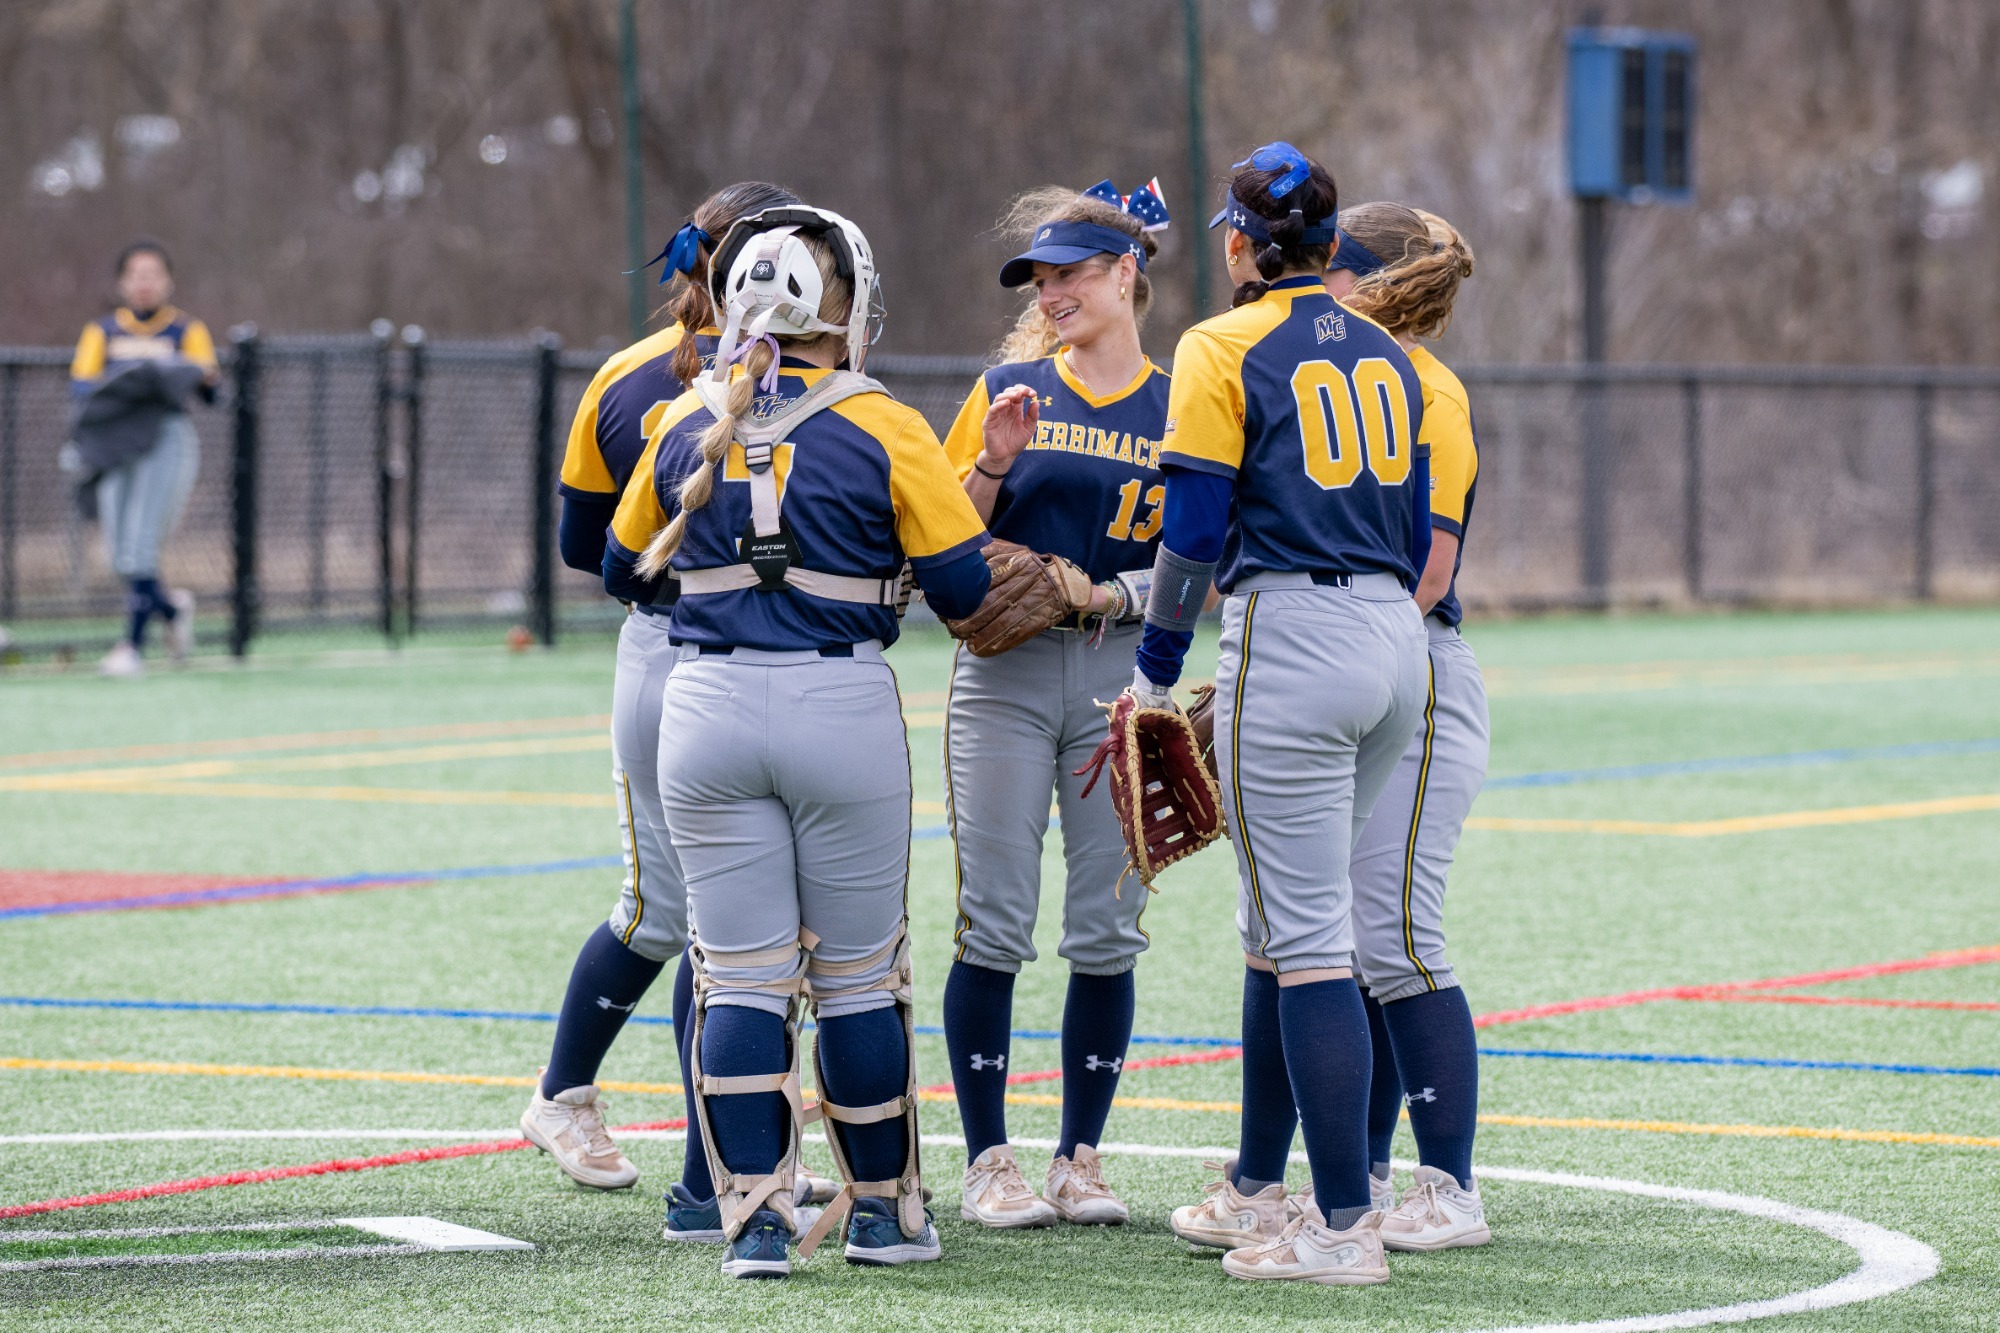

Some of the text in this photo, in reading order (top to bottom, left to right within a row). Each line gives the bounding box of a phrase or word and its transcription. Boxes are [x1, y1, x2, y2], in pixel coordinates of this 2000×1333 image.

[1313, 310, 1347, 345] MC
[1023, 419, 1164, 471] ERRIMACK
[1290, 357, 1411, 490] 00
[1106, 478, 1167, 542] 13
[751, 543, 787, 552] EASTON
